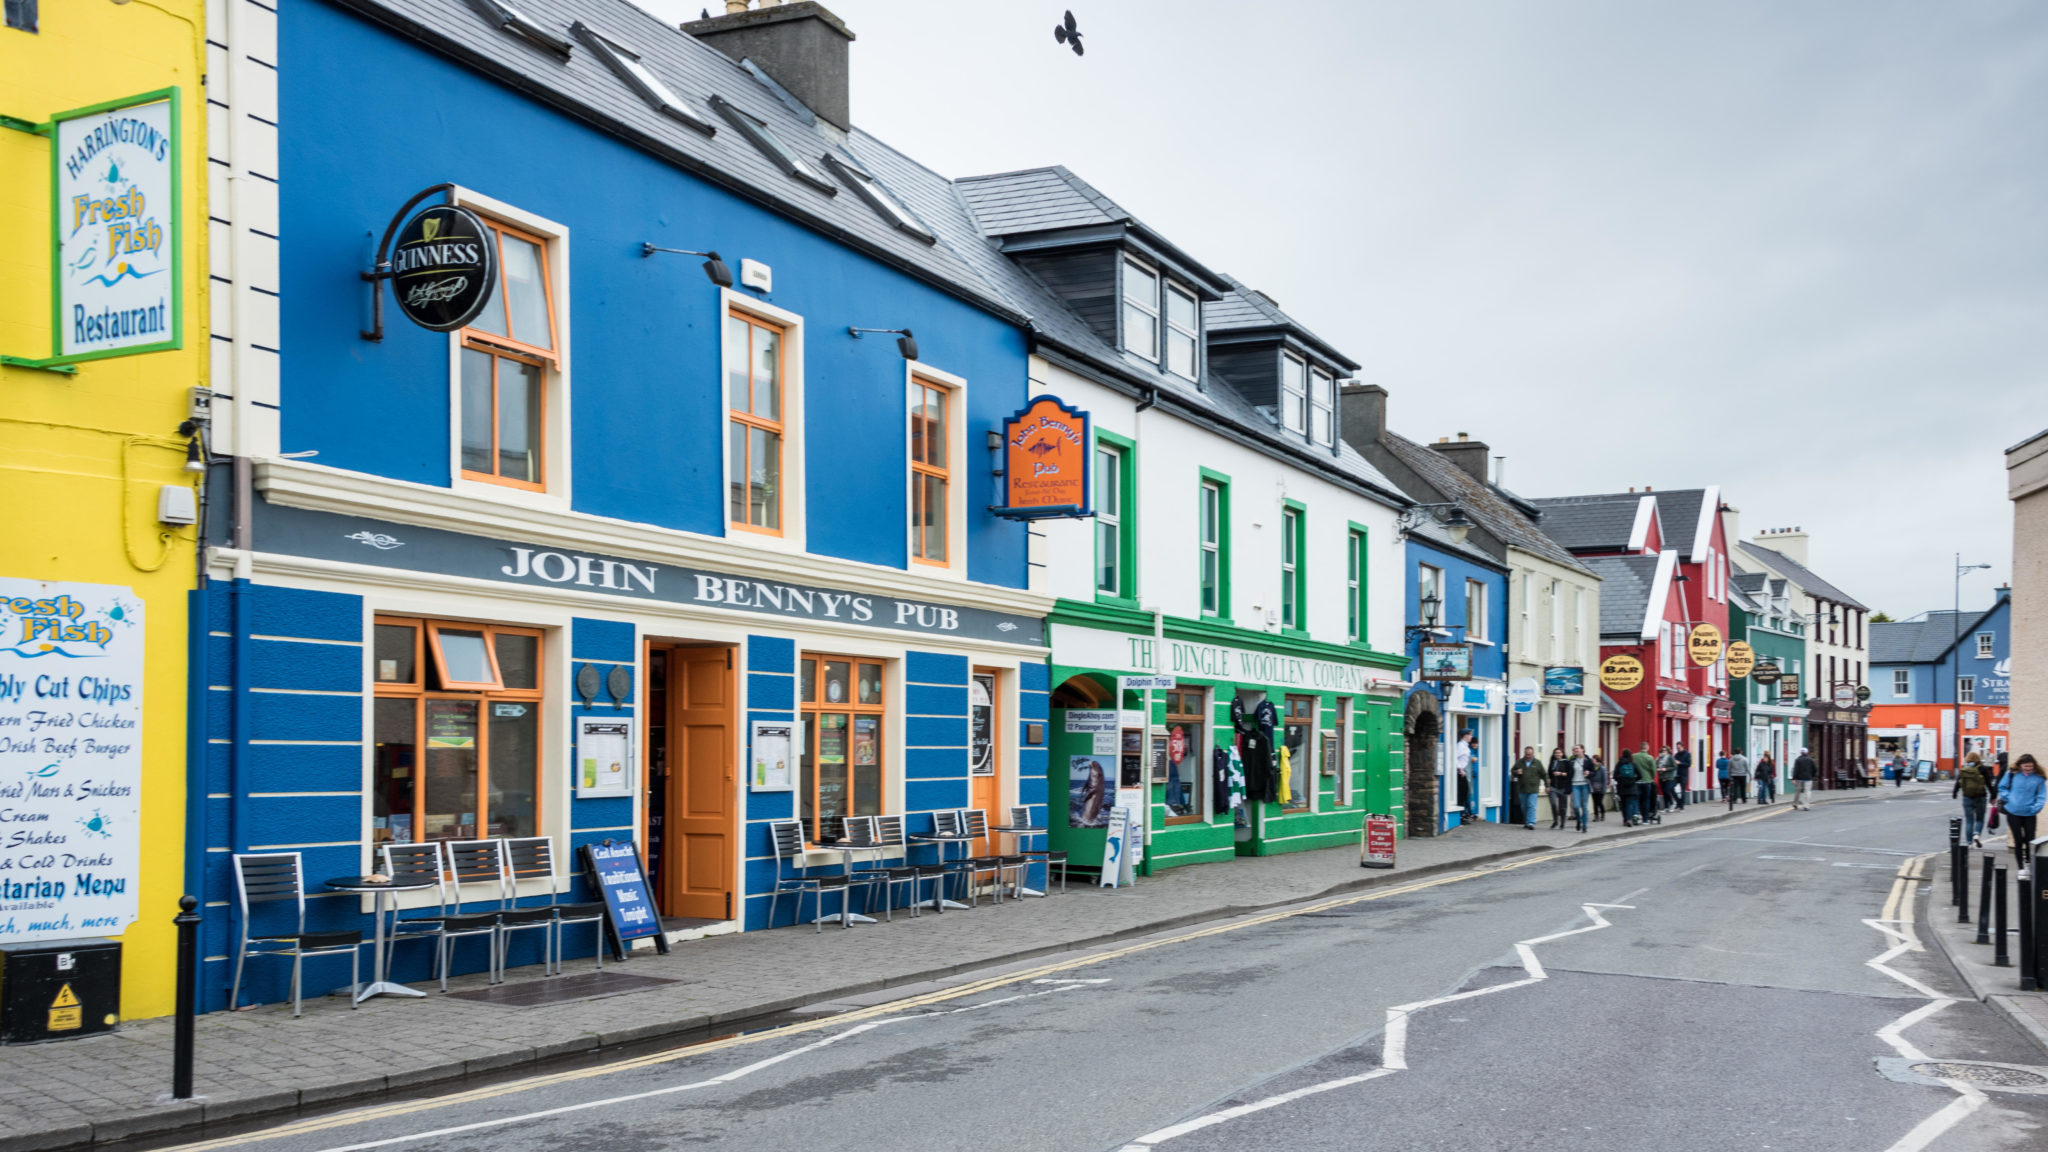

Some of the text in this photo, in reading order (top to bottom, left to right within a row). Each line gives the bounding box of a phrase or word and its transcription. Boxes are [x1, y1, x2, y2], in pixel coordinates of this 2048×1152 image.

[66, 117, 170, 181] HARRINGTON'S
[71, 184, 146, 239] Fresh
[106, 217, 163, 268] Fish
[394, 244, 478, 273] GUINNESS
[73, 295, 165, 344] Restaurant
[1010, 424, 1038, 450] John
[1032, 462, 1060, 478] Pub
[501, 547, 960, 631] JOHN BENNY'S PUB
[16, 616, 113, 650] Fish
[1693, 638, 1718, 647] BAR
[1128, 638, 1364, 692] TH DINGLE WOOLLEN COMPANY
[35, 674, 69, 699] Cut
[78, 675, 132, 705] Chips
[1126, 677, 1171, 687] Dolphin Trips
[26, 710, 74, 732] Fried
[78, 712, 135, 729] Chicken
[1075, 723, 1103, 731] Passenger
[41, 737, 78, 758] Beef
[82, 738, 131, 759] Burger
[24, 781, 60, 802] Mars
[64, 784, 74, 797] &
[76, 779, 132, 801] Snickers
[0, 808, 49, 822] Cream
[5, 830, 67, 849] Shakes
[0, 853, 113, 870] & Cold Drinks
[74, 873, 126, 899] Menu
[81, 916, 119, 928] more
